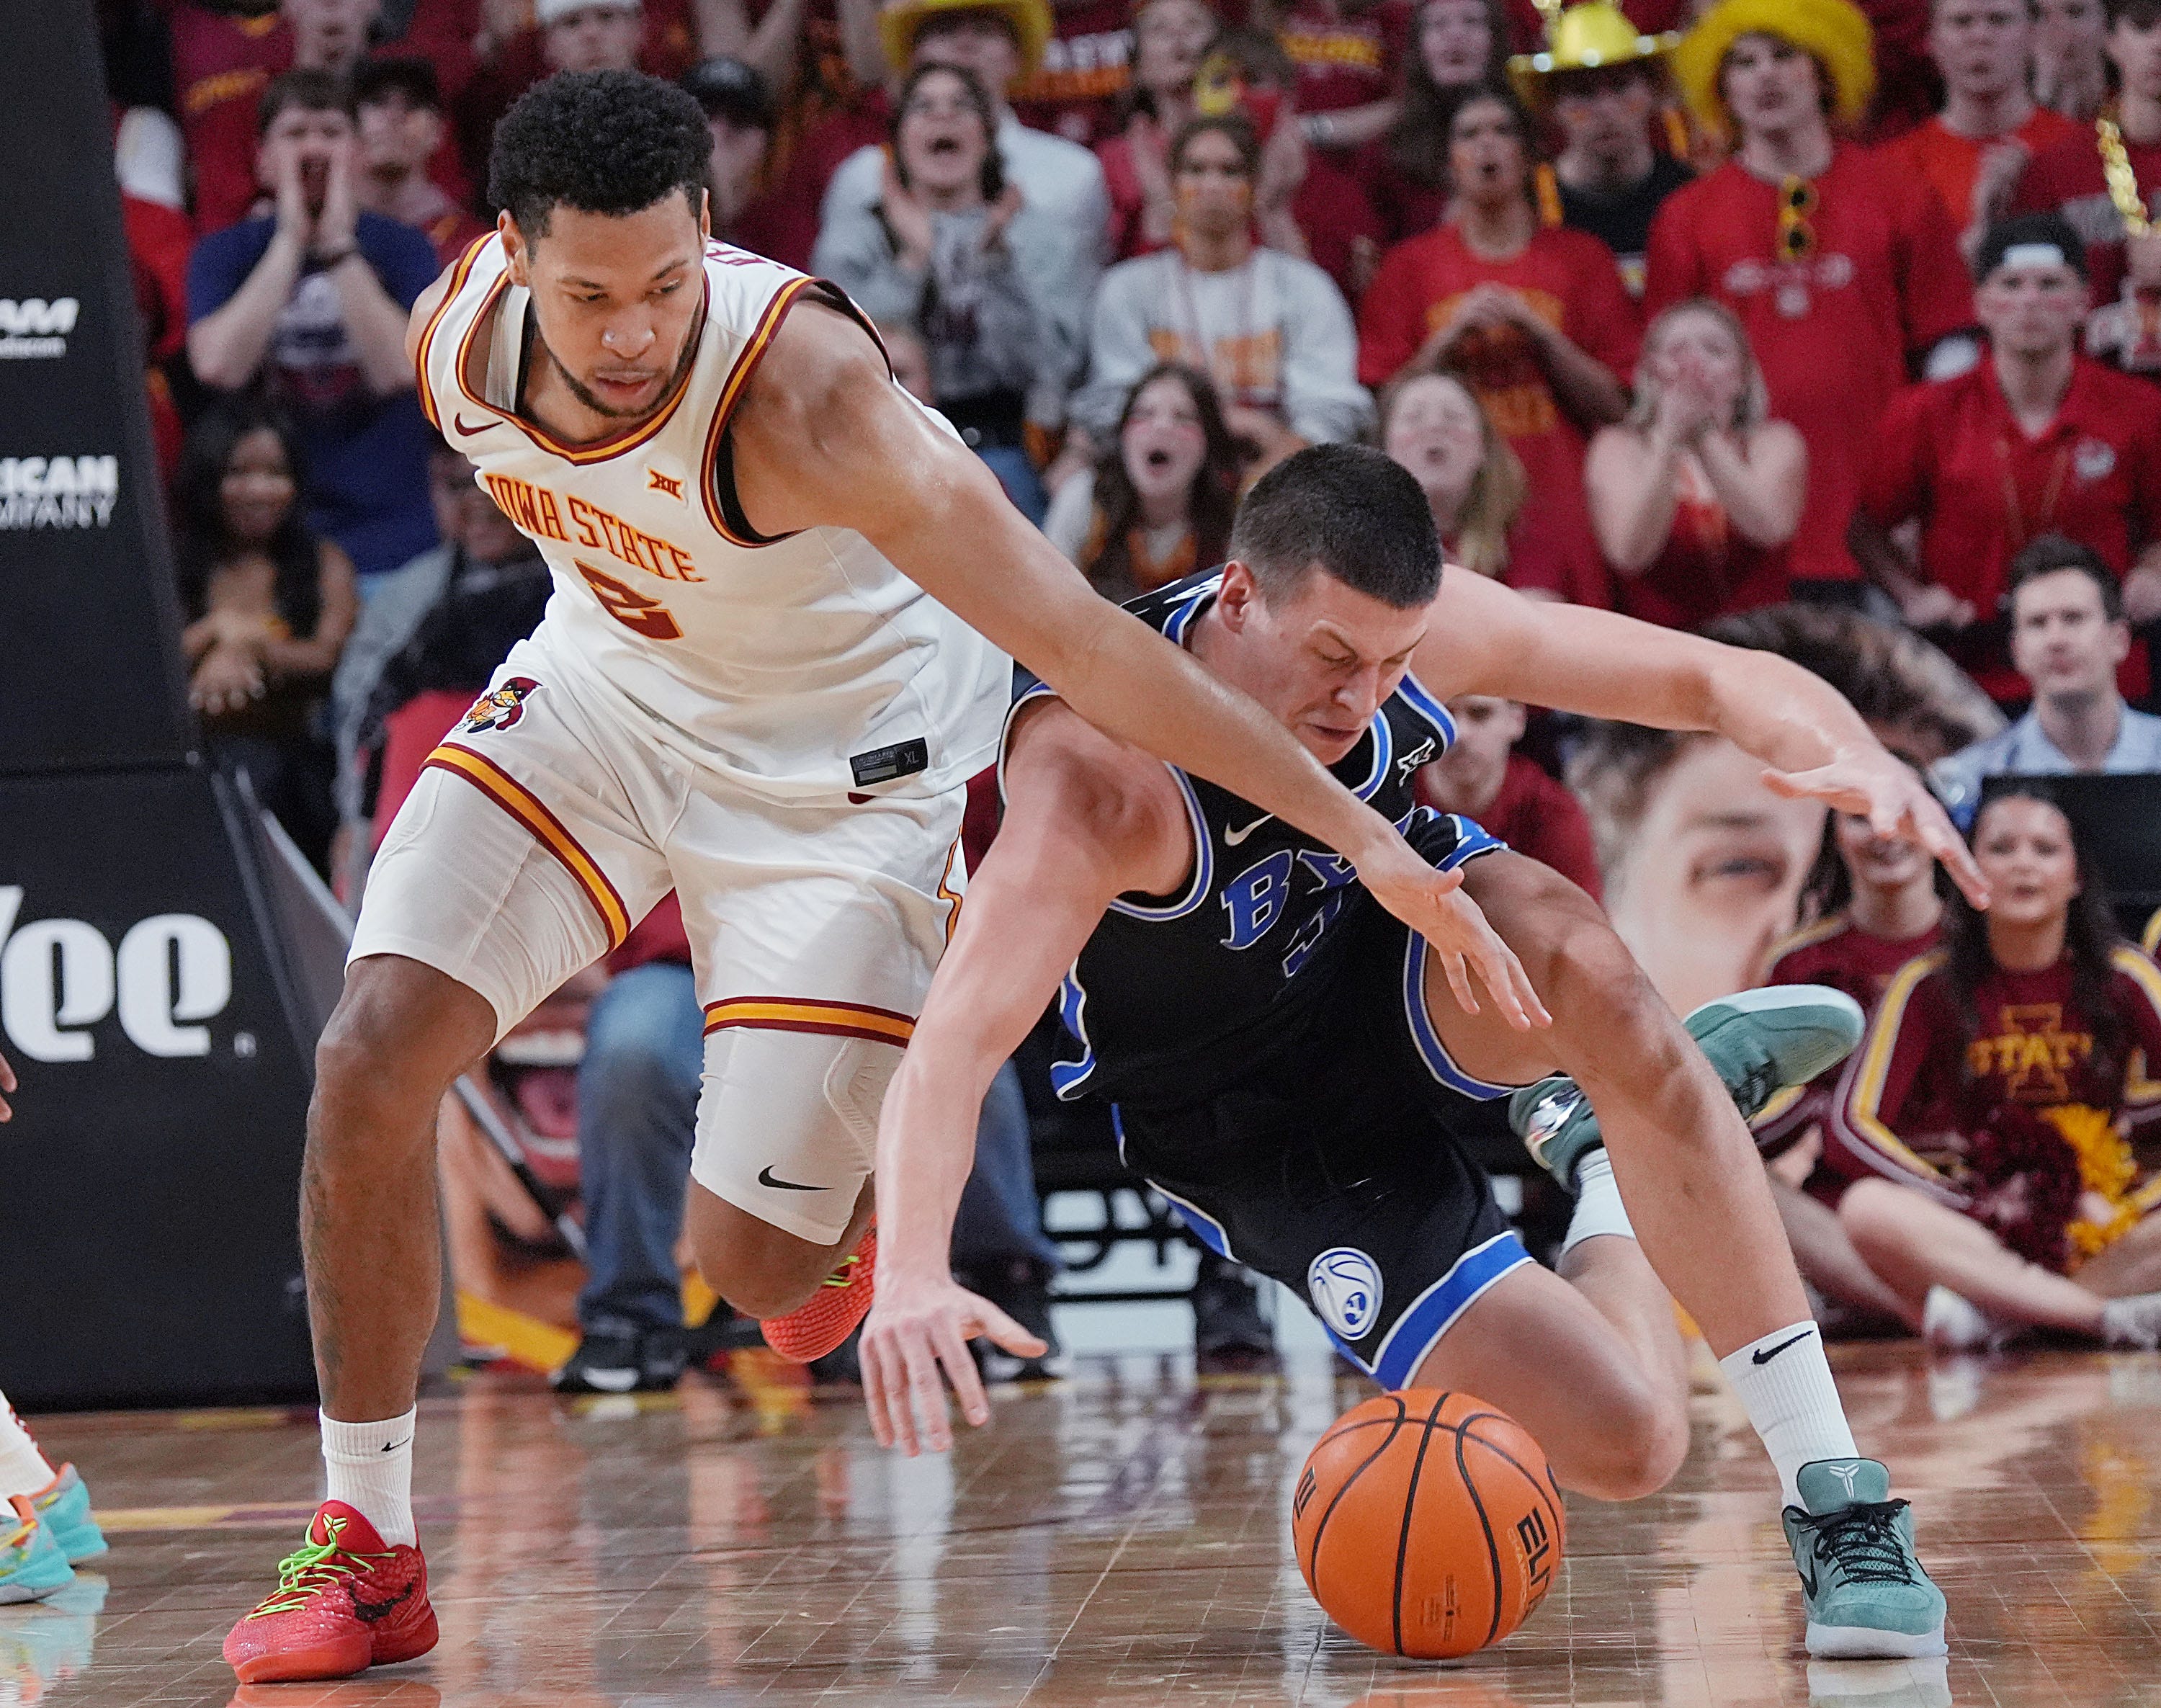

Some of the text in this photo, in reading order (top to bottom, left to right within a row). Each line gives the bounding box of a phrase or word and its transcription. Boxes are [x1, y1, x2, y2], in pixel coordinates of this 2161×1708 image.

[484, 473, 710, 583] IOWA STATE
[573, 557, 684, 641] 2
[904, 751, 919, 764] XL
